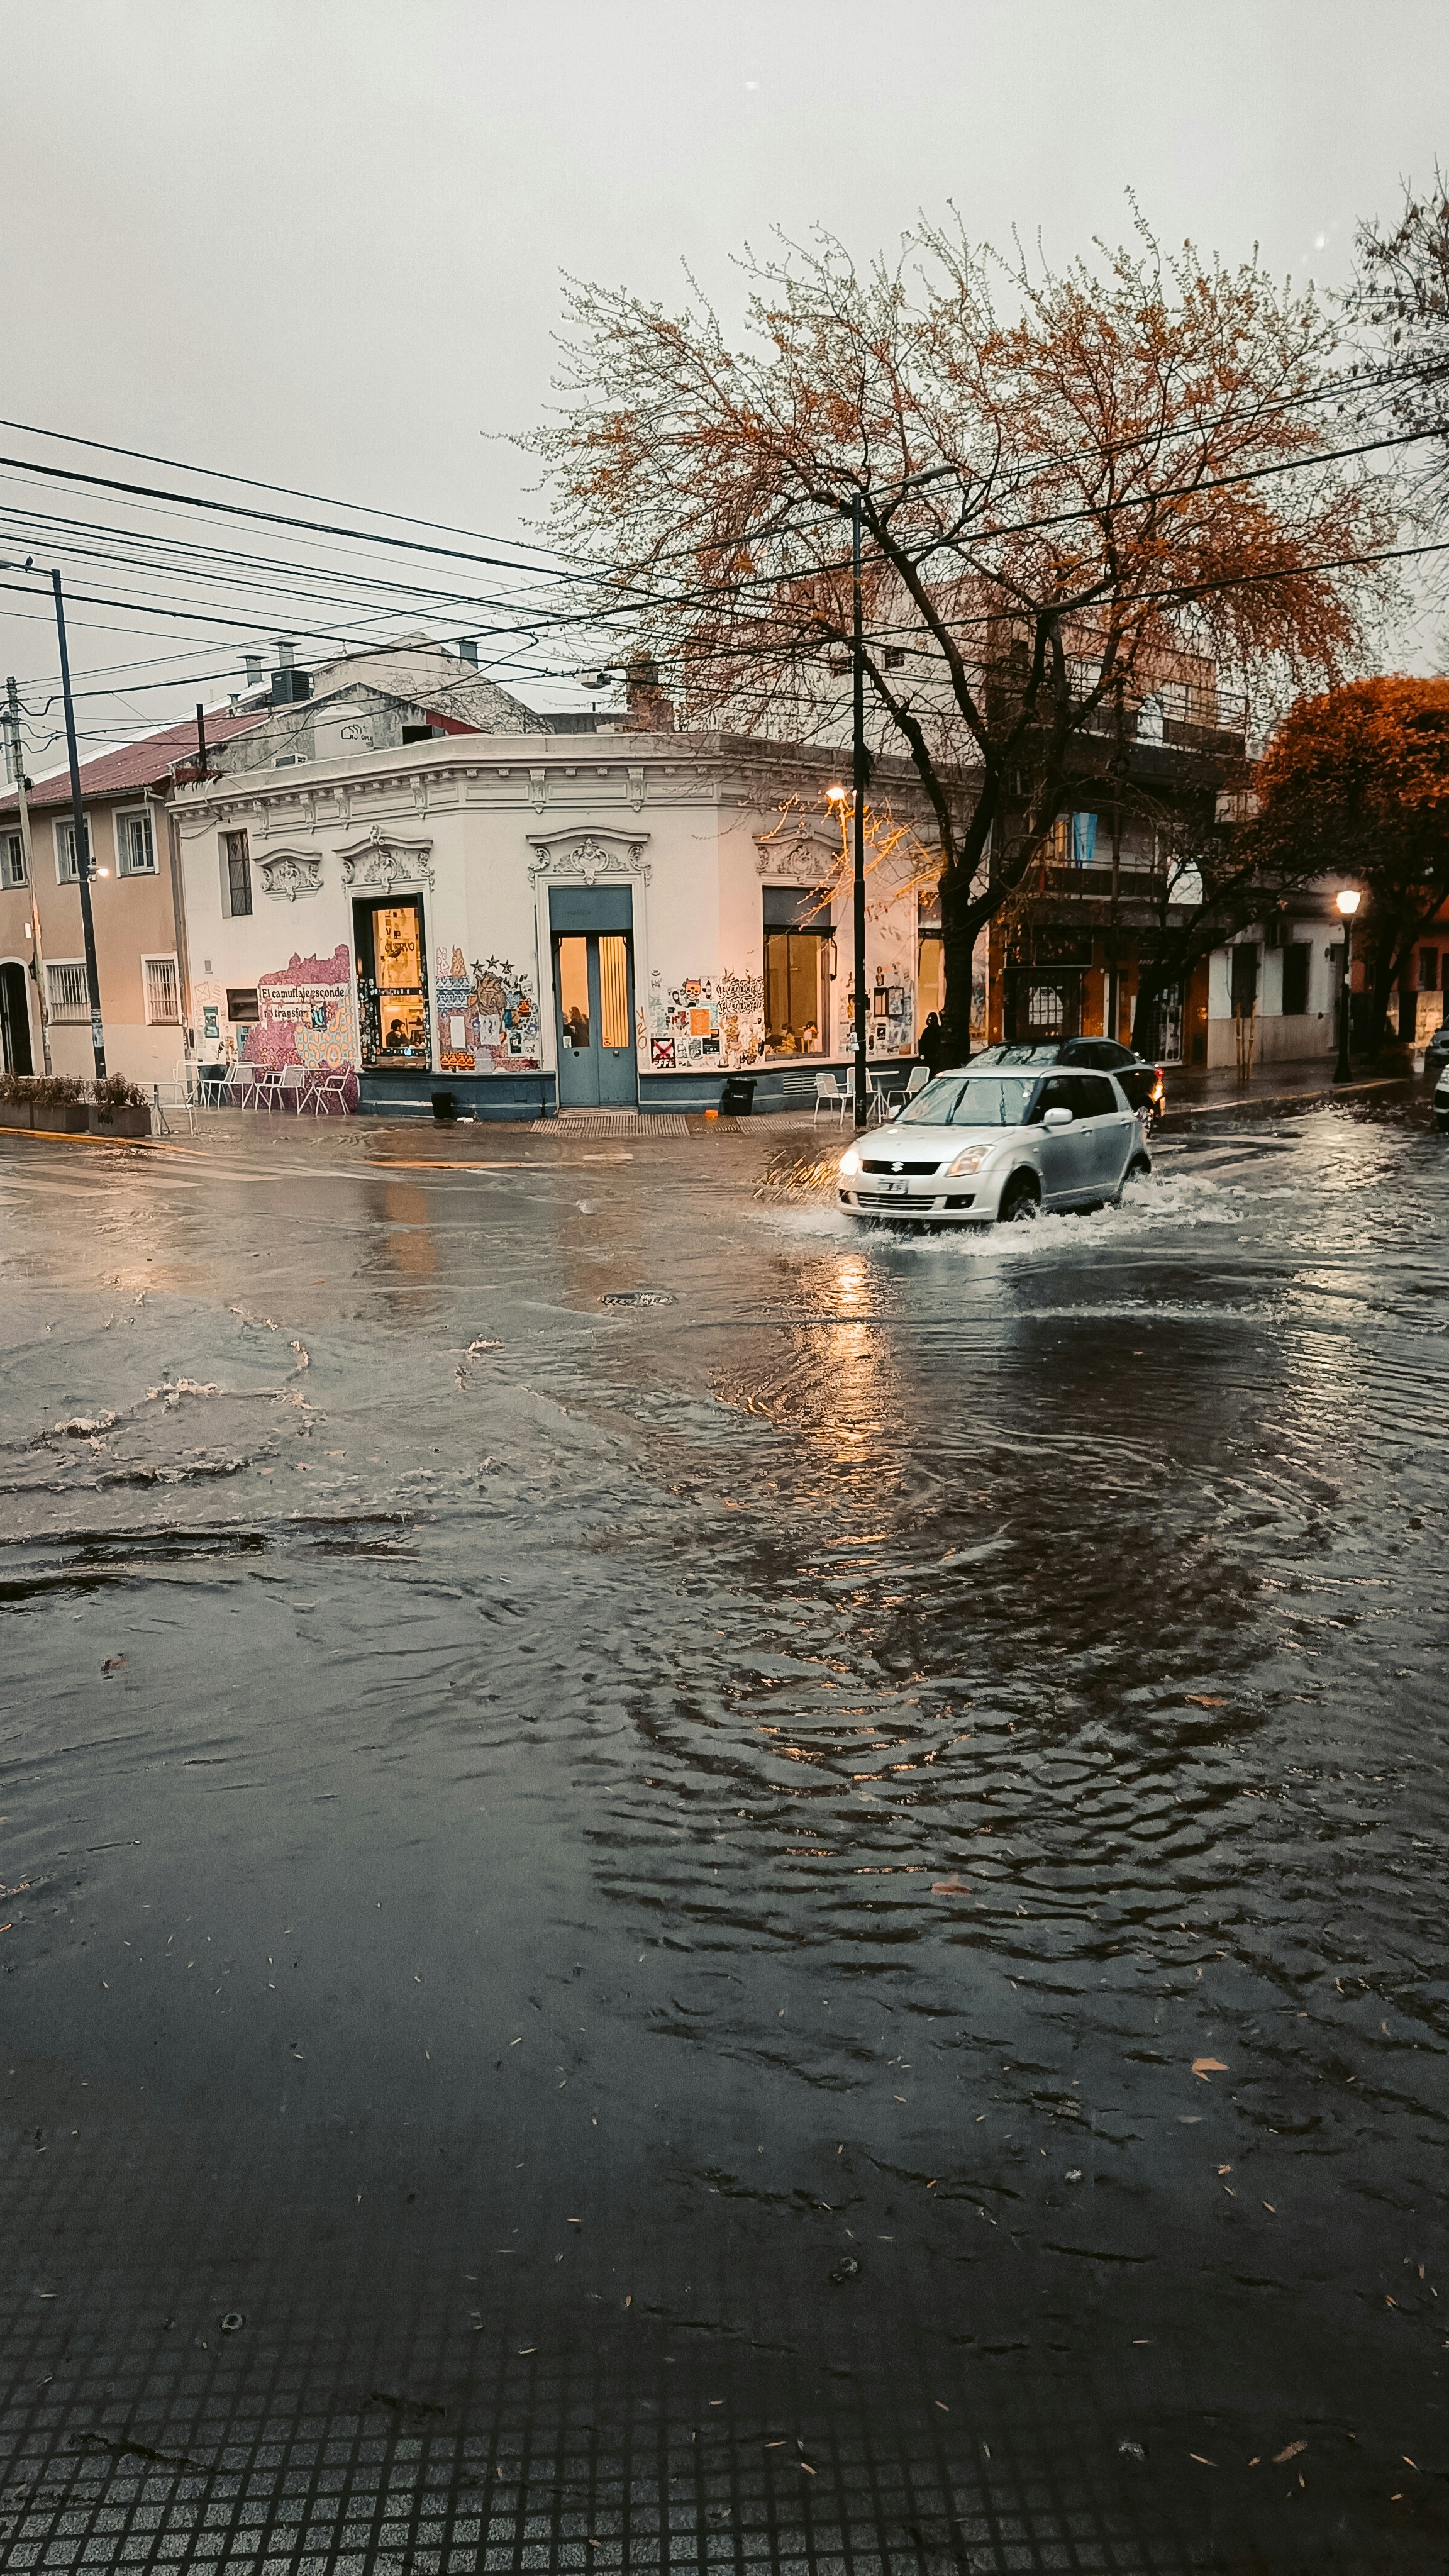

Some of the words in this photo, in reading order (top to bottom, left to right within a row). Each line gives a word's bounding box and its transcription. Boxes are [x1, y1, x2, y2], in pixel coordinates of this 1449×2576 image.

[262, 988, 270, 998] El
[272, 987, 309, 1004] camuflaje
[311, 987, 344, 997] esconde
